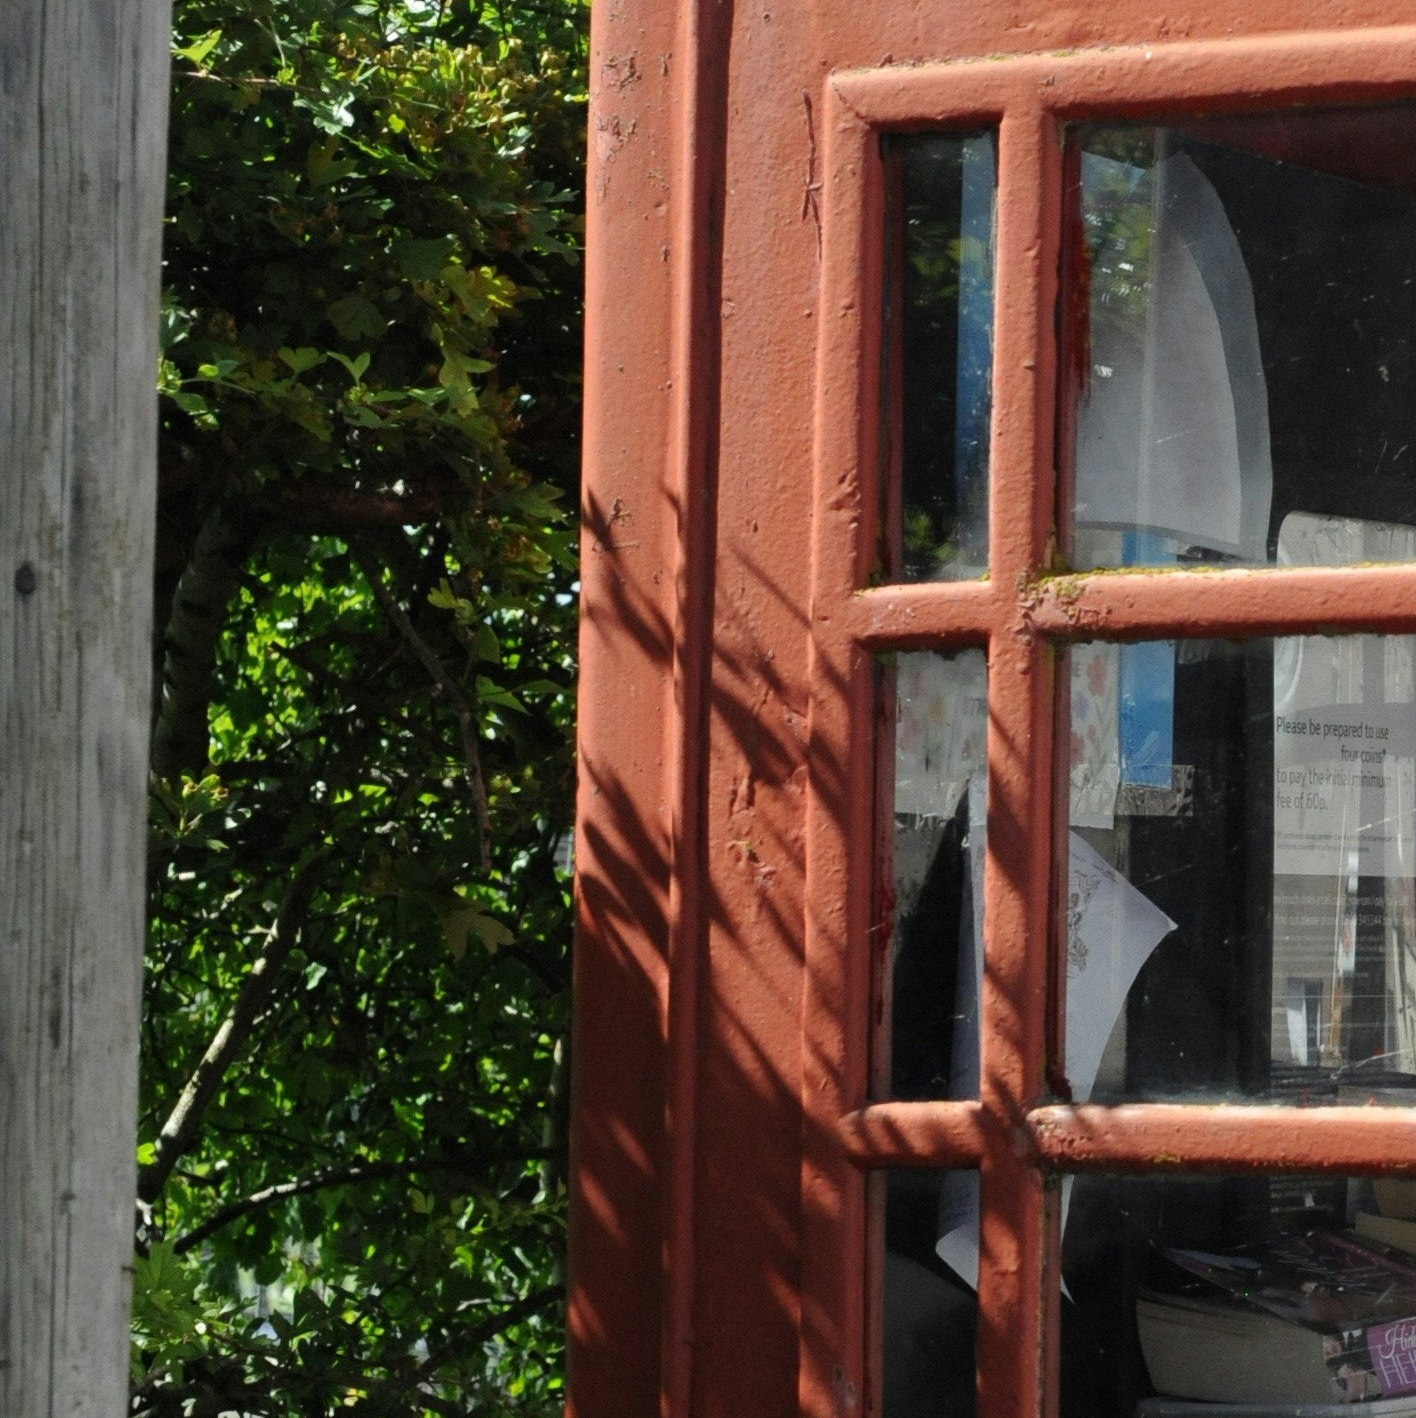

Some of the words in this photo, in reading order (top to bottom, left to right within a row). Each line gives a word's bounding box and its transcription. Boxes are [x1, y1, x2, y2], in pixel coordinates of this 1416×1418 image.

[1276, 716, 1308, 736] Please
[1309, 718, 1321, 737] be
[1323, 722, 1363, 741] prepared
[1364, 723, 1374, 739] to
[1375, 727, 1390, 740] use
[1340, 744, 1359, 762] four
[1276, 768, 1287, 784] to
[1289, 771, 1307, 789] pay
[1308, 769, 1326, 786] the
[1276, 790, 1292, 810] fee
[1294, 791, 1305, 810] of
[1306, 793, 1329, 812] 60p.
